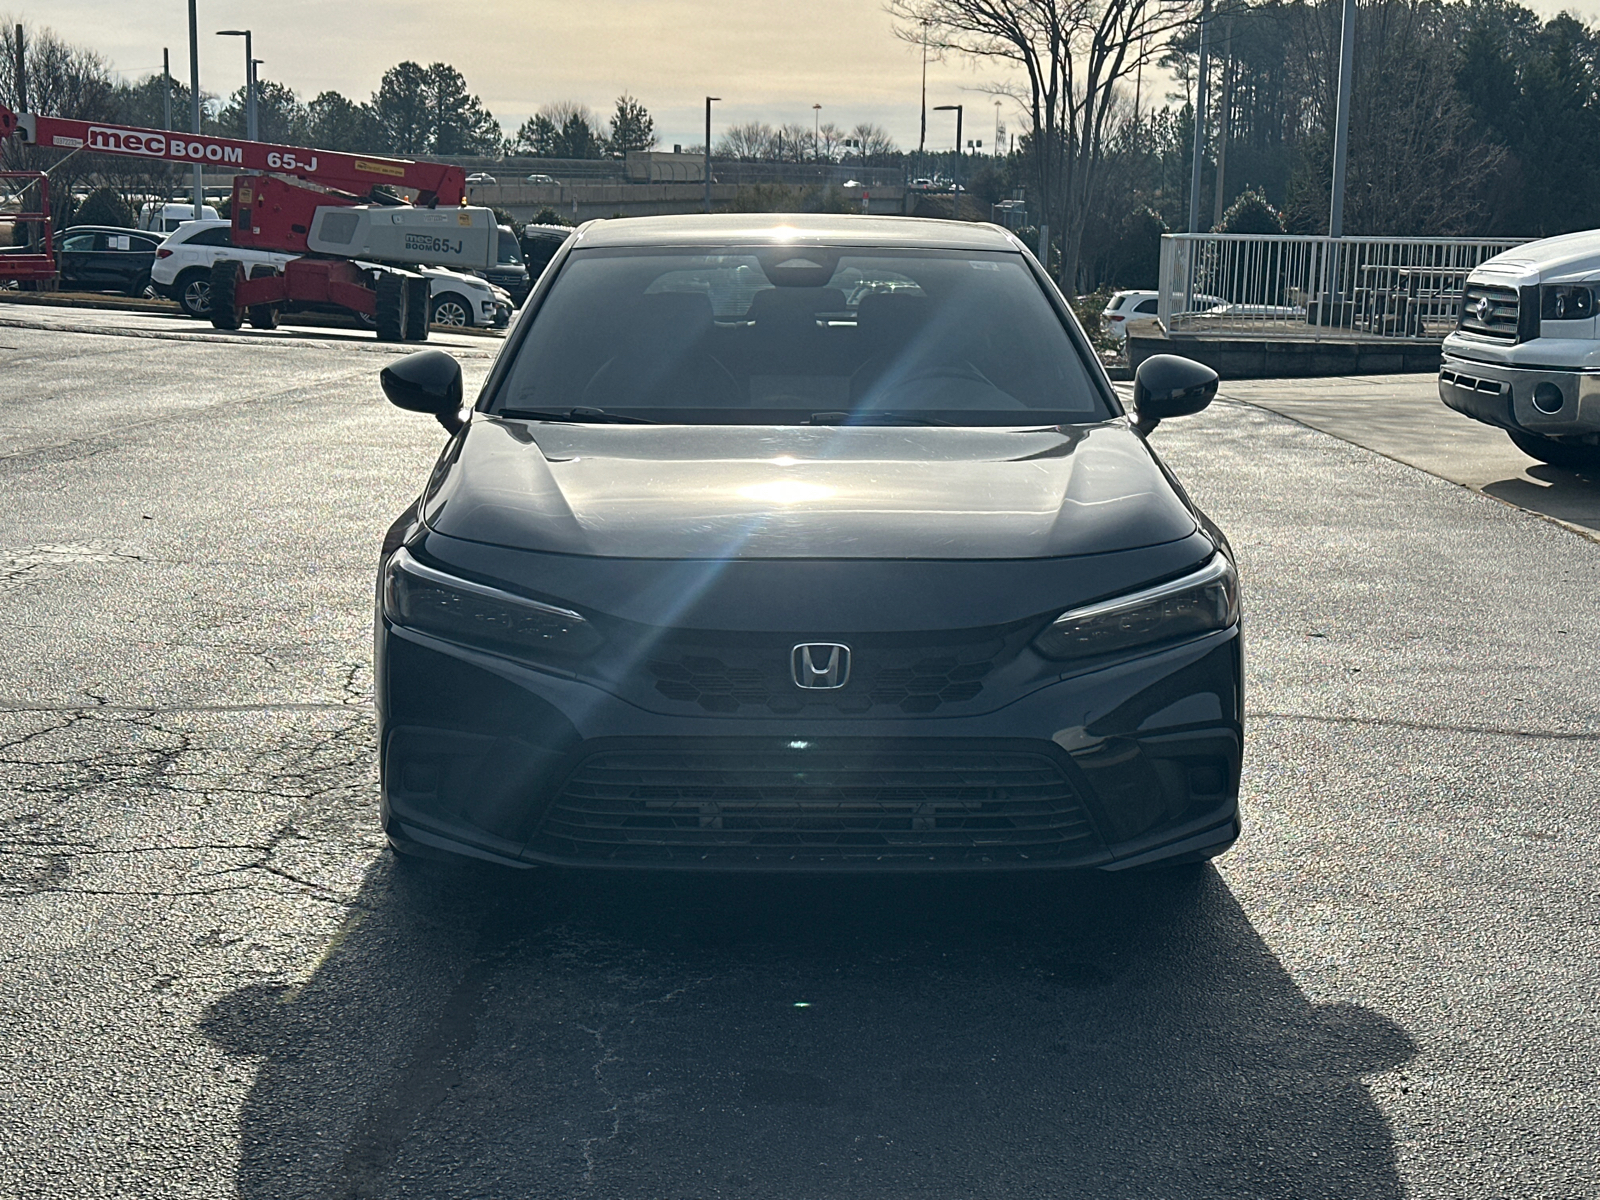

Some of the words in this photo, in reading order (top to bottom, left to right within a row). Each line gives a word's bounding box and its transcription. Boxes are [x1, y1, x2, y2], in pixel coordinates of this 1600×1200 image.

[90, 129, 165, 154] mec
[170, 142, 243, 164] BOOM
[266, 152, 318, 172] 65-J
[405, 234, 433, 245] mec
[405, 243, 433, 252] BOOM
[432, 238, 463, 254] 65-J
